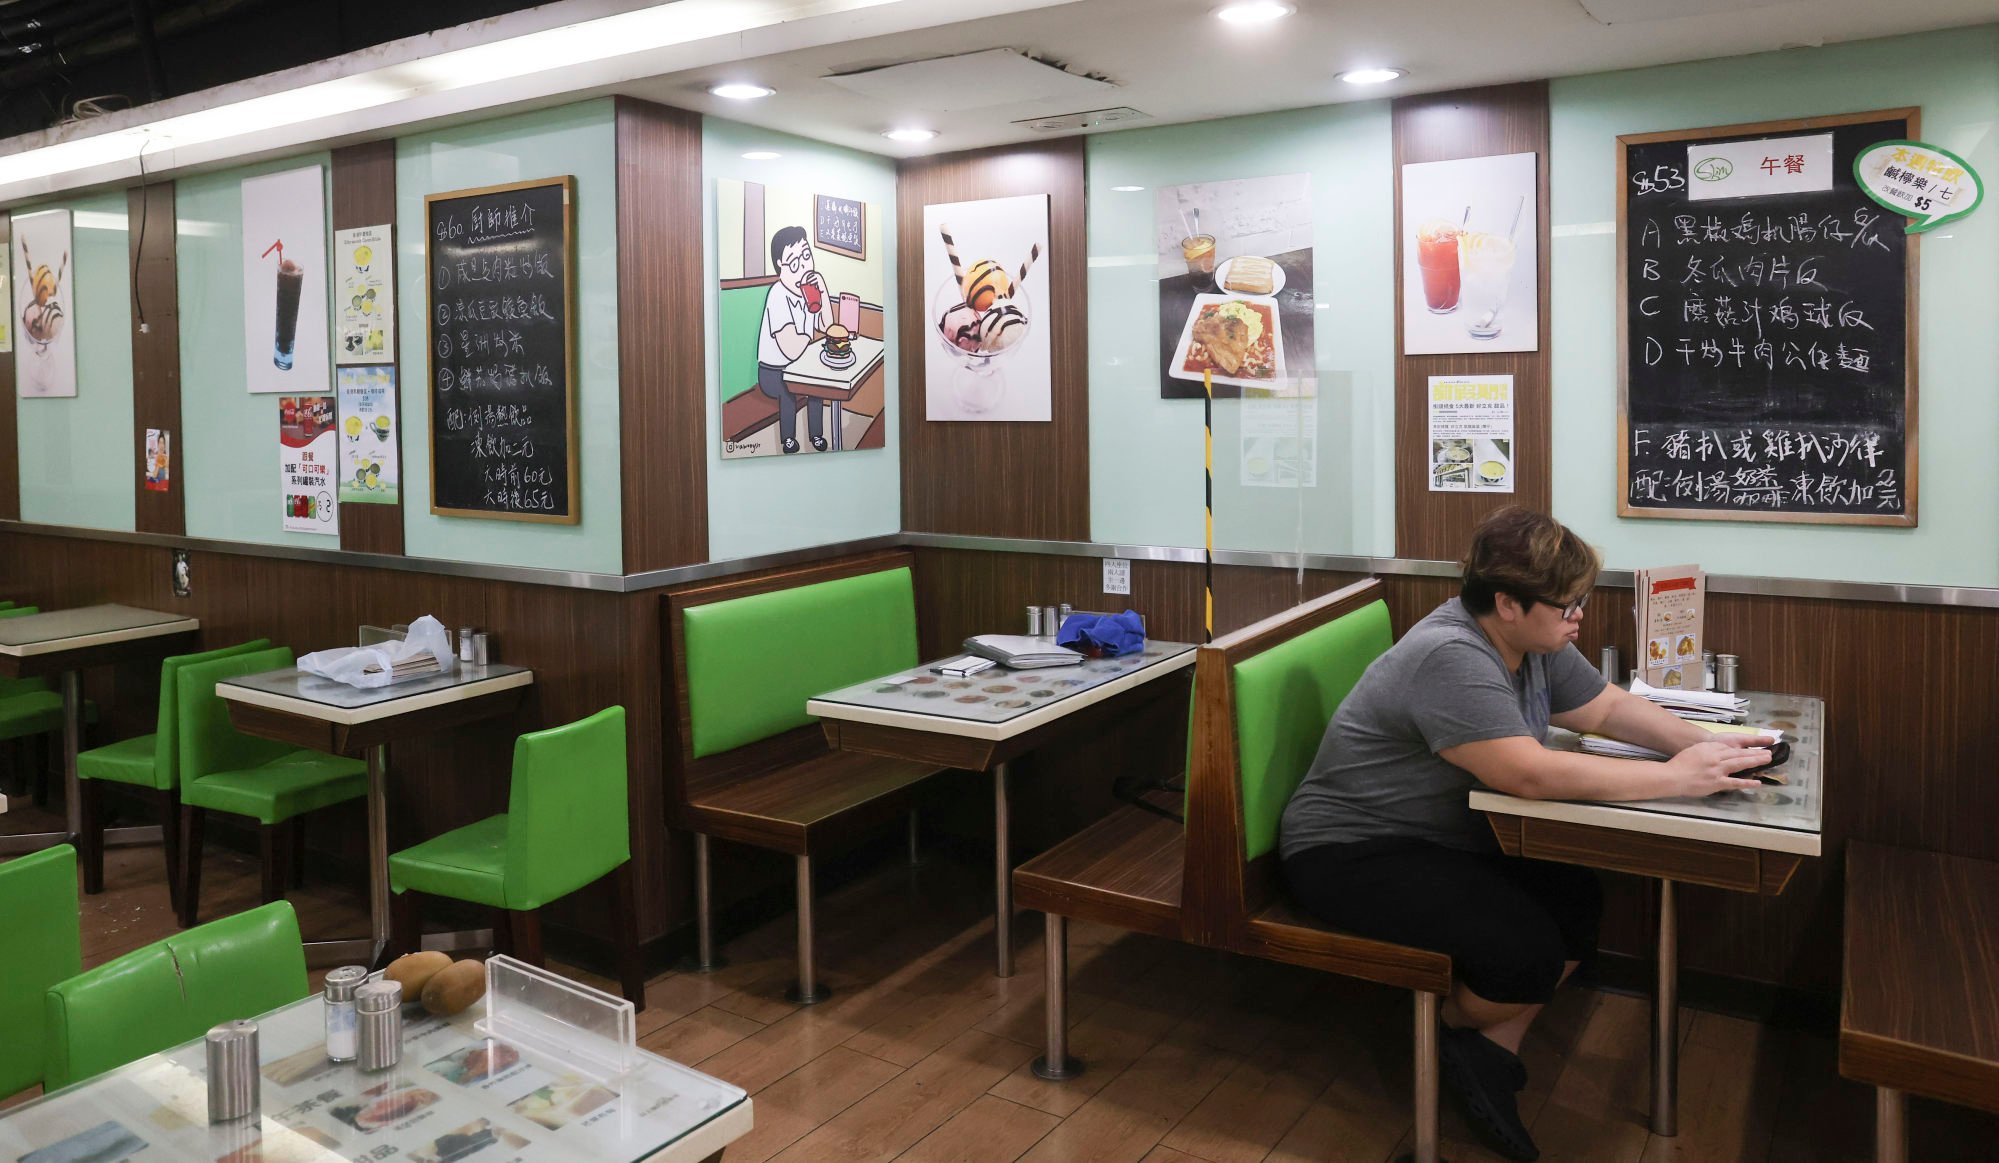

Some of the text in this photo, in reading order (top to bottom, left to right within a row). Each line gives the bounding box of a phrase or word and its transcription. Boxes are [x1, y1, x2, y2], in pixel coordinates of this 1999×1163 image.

[1760, 154, 1805, 176] 午餐
[1914, 196, 1932, 211] $5
[1641, 218, 1661, 249] A
[1643, 259, 1661, 281] B
[1640, 296, 1661, 316] C
[1645, 336, 1663, 366] D
